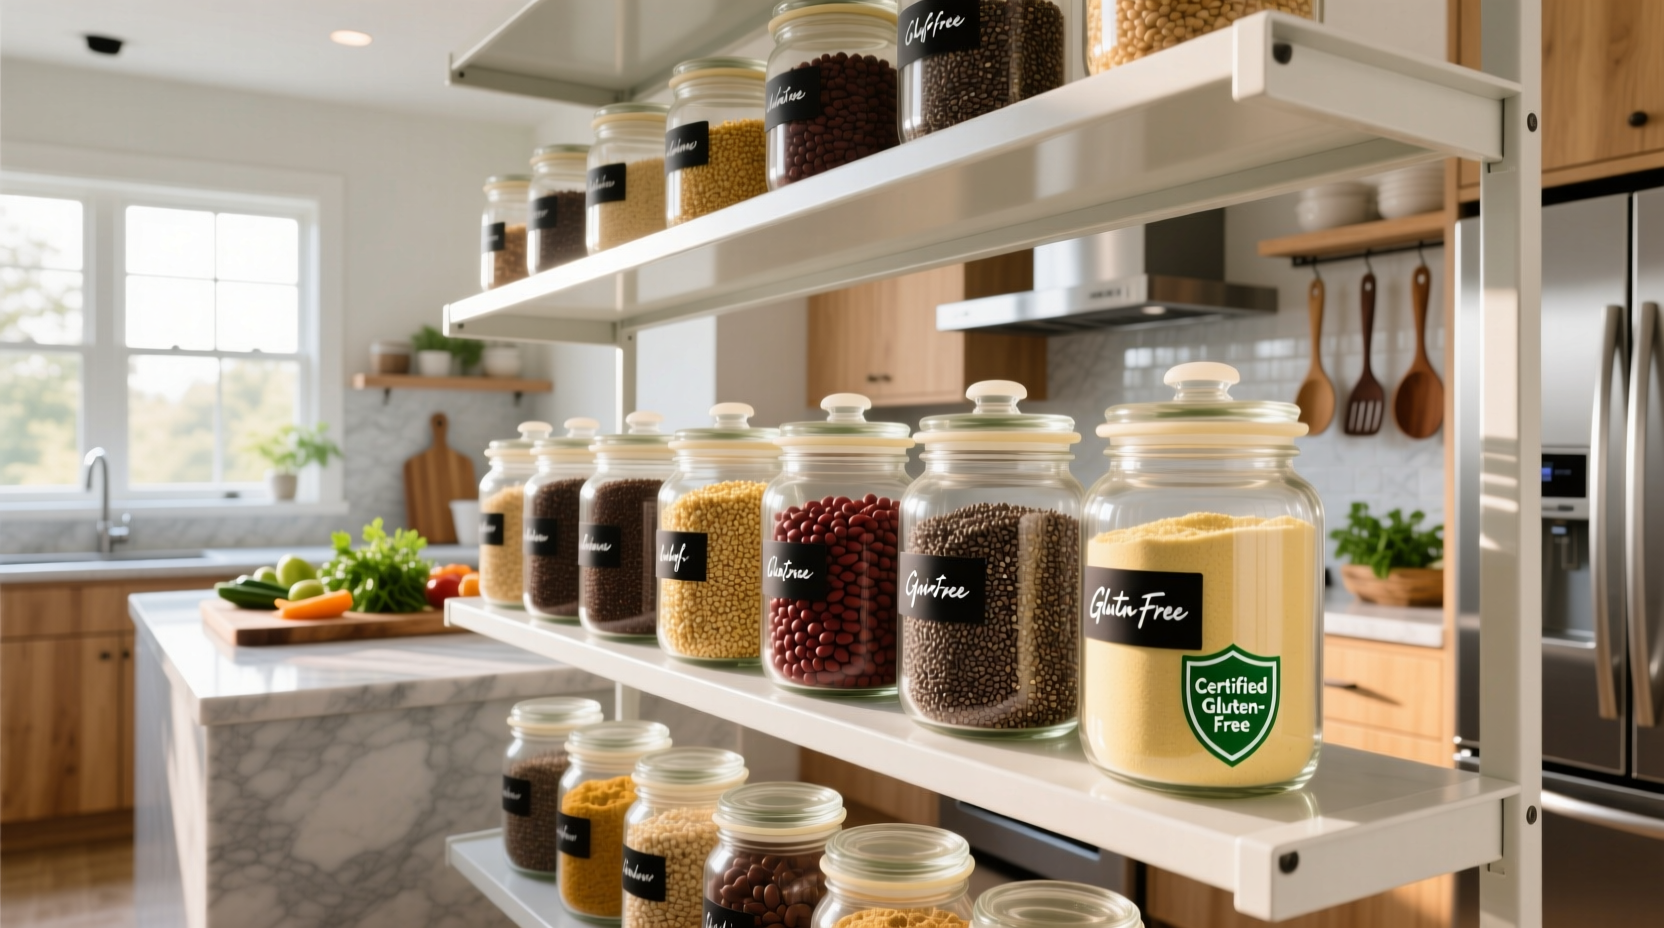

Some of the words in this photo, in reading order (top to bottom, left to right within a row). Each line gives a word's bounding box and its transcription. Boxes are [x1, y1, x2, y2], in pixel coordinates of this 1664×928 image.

[1137, 591, 1189, 629] Free
[1195, 676, 1268, 694] Certified
[1201, 696, 1265, 714] Gluten-
[1213, 715, 1251, 733] Free
